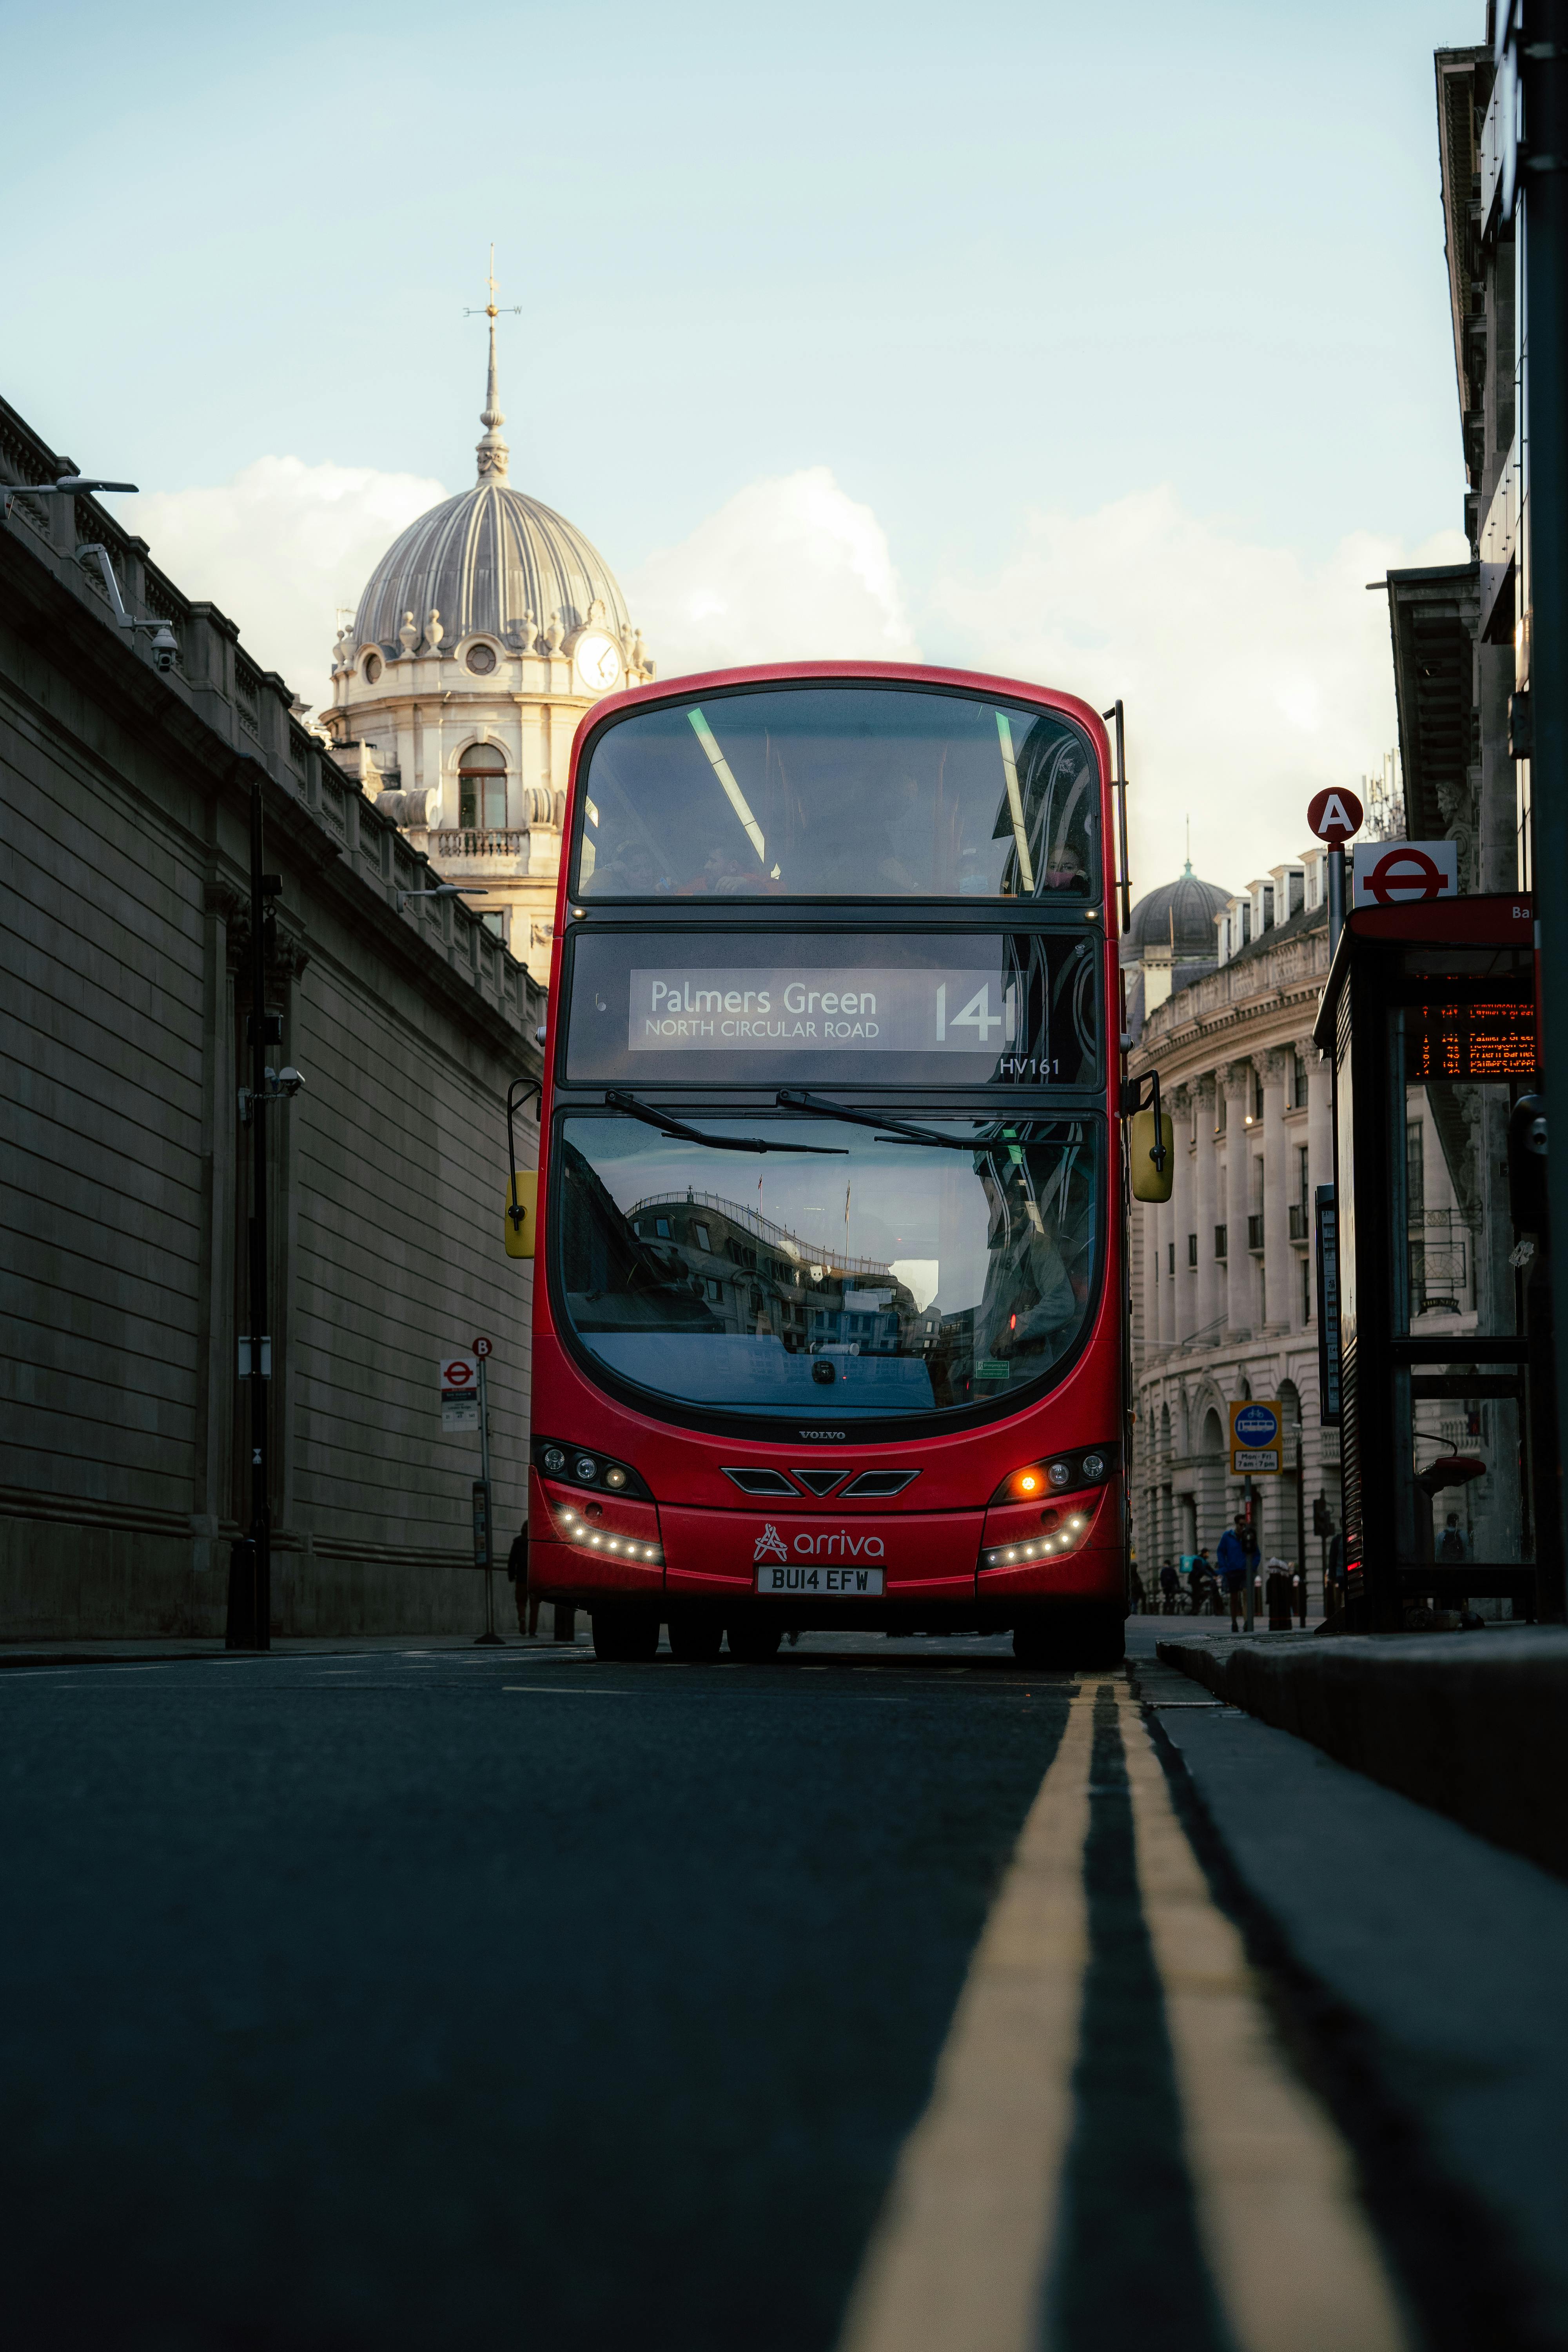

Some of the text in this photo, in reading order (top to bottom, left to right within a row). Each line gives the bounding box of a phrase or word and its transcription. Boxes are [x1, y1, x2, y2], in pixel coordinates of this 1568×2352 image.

[1318, 795, 1354, 833] A
[652, 981, 1015, 1041] Palmers Green 141
[646, 1020, 879, 1038] NORTH CIRCULAR ROAD
[1000, 1059, 1058, 1074] HV161
[478, 1340, 488, 1354] B
[799, 1431, 846, 1439] VOLVO
[794, 1530, 884, 1557] arriva
[772, 1569, 868, 1591] BU14 EFW
